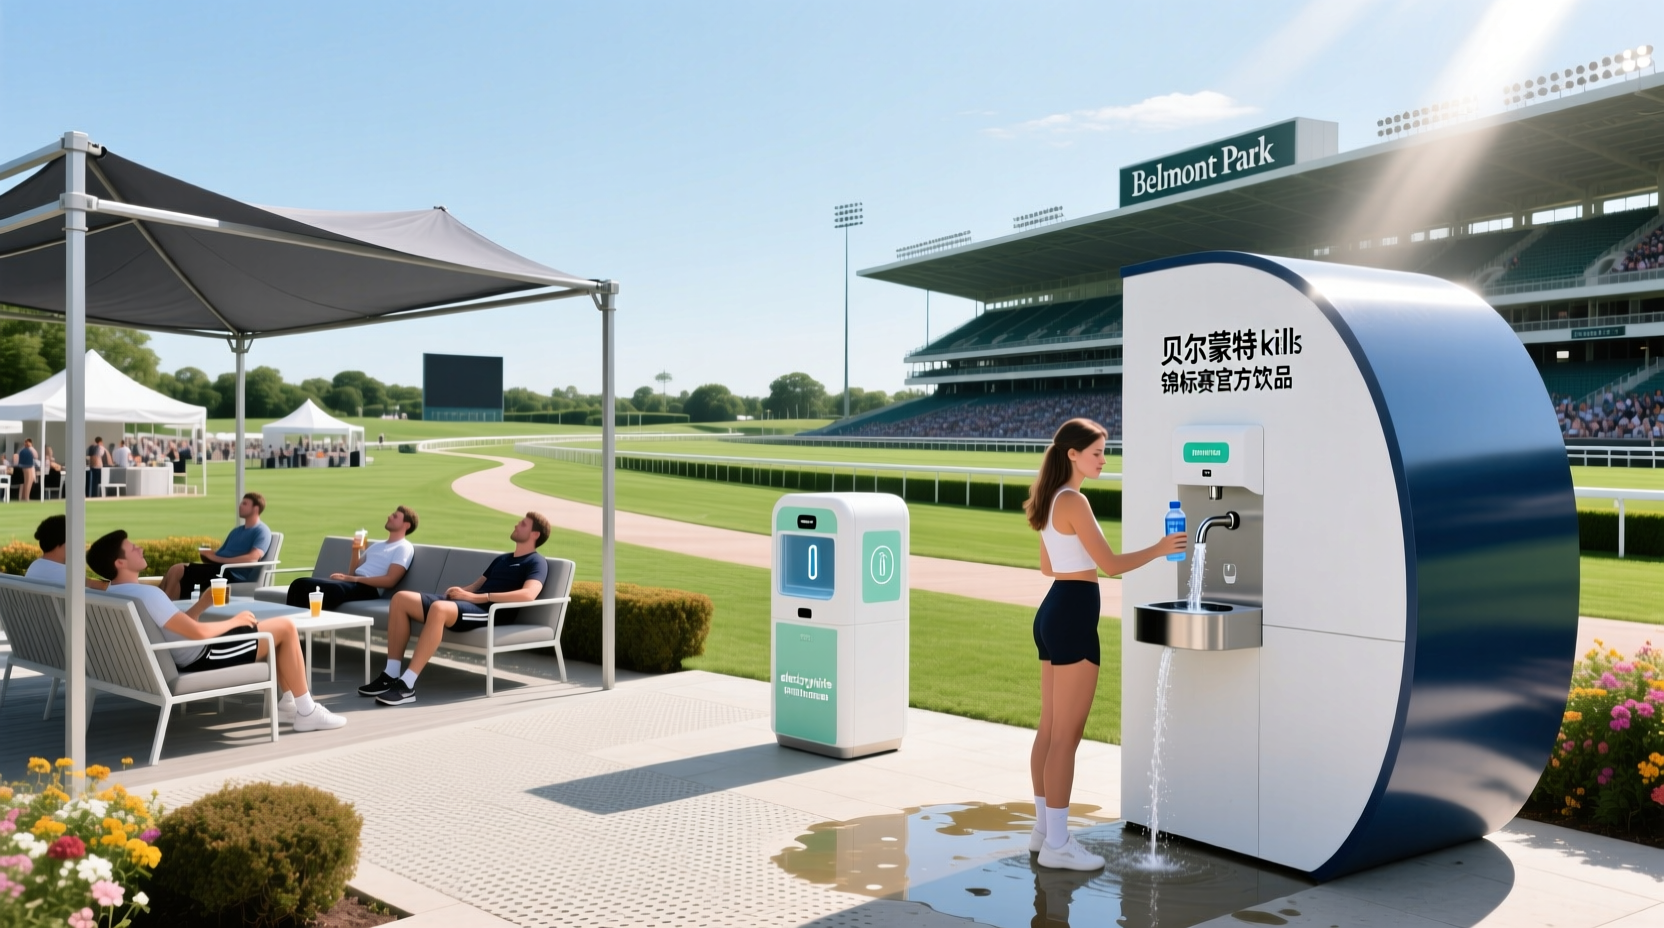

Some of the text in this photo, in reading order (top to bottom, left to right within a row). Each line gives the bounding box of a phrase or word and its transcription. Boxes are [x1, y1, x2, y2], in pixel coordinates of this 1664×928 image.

[1131, 135, 1275, 197] Belmont Park
[1161, 365, 1293, 395] 锦标赛官方饮品
